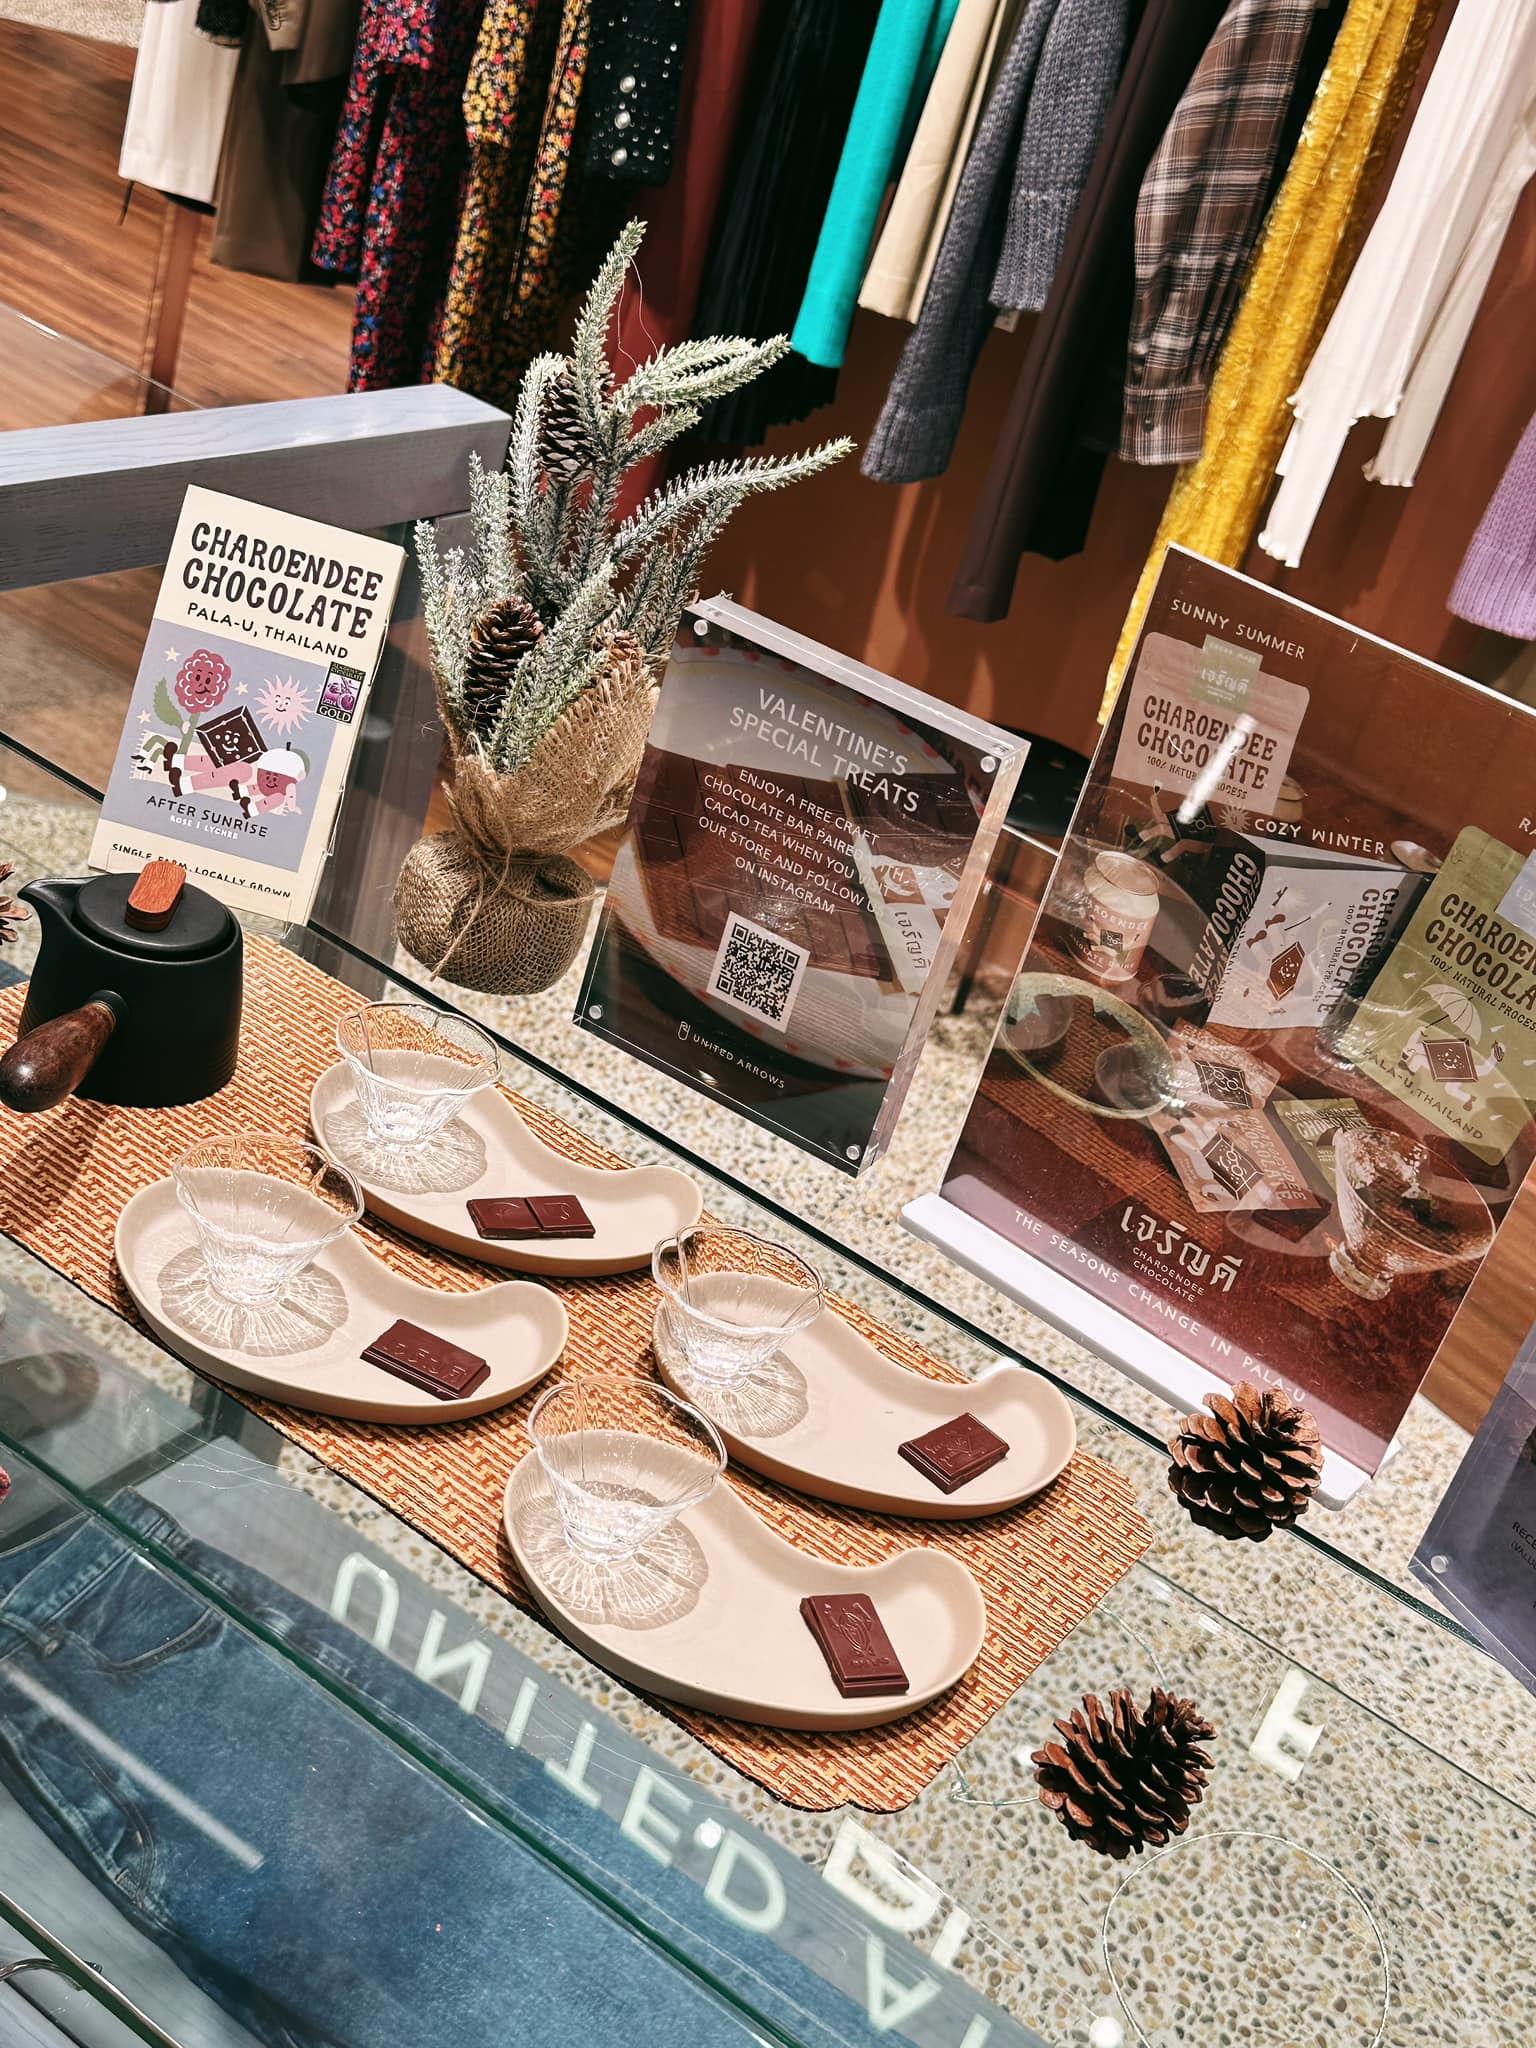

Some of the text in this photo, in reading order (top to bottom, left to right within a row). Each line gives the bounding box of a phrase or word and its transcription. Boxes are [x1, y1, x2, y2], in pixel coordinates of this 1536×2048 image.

[191, 522, 384, 601] CHAROENDEE
[183, 558, 373, 639] CHOCOLATE
[187, 603, 349, 660] PALA-U, THAILAND
[1171, 599, 1230, 630] SUNNY
[1235, 623, 1305, 660] SUMMER
[319, 705, 351, 722] GOLD
[729, 706, 920, 813] SPECIAL TREATS
[1137, 723, 1270, 790] CHOCOATE
[146, 795, 270, 839] AFTER SUNRISE
[170, 815, 192, 827] ROSE
[204, 824, 239, 840] LYCHEE
[703, 774, 785, 823] CHOCOLATE
[786, 814, 814, 839] BAR
[816, 828, 864, 860] PAIRED
[738, 769, 881, 846] ENJOY A FREE CRAFT
[1254, 818, 1385, 855] COZY WINTER
[698, 816, 727, 839] OUR
[728, 831, 772, 861] STORE
[774, 854, 804, 876] AND
[805, 870, 865, 907] FOLLOW
[704, 797, 750, 827] CACAO
[753, 820, 778, 843] TEA
[782, 834, 824, 865] WHEN
[826, 855, 856, 879] YOU
[195, 866, 246, 887] LOCALLY
[734, 856, 837, 915] ON INSTAGRAM
[1188, 852, 1257, 990] CHOCOLATE
[1453, 970, 1497, 1007] NATURAL
[693, 1033, 785, 1089] UNITED ARROWS
[1415, 1088, 1484, 1140] THAILAND
[1132, 1247, 1205, 1296] CHAROENDEE
[1133, 1260, 1196, 1303] CHOCOLATE
[1014, 1209, 1308, 1404] THE SEASONS CHANGE IN PALA-U
